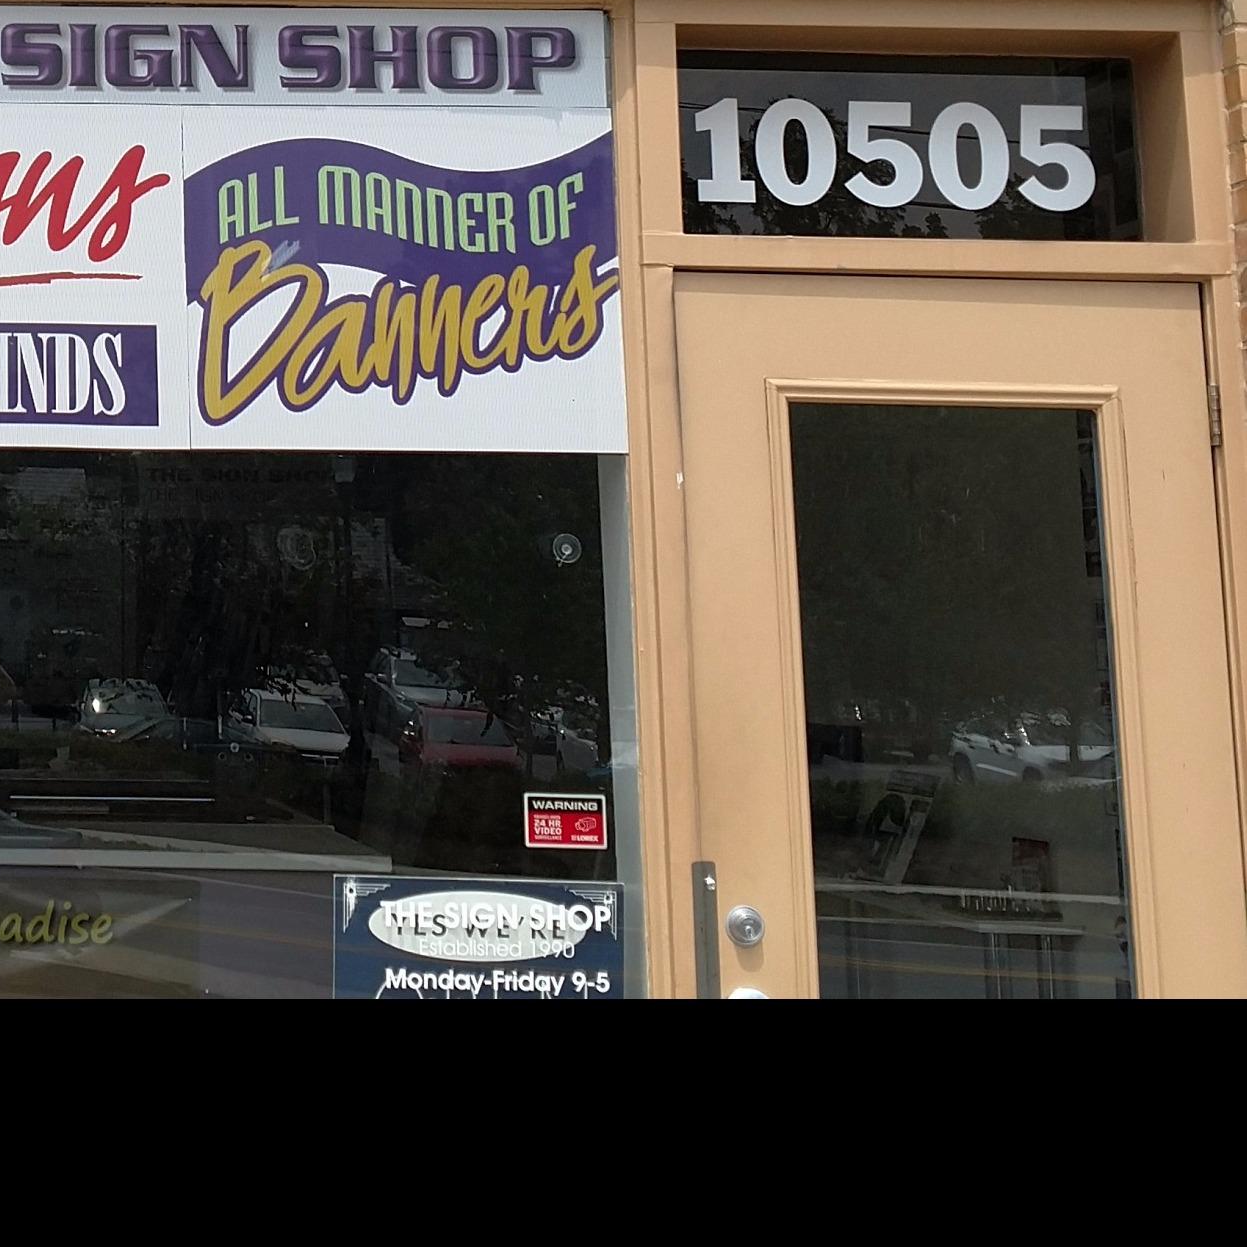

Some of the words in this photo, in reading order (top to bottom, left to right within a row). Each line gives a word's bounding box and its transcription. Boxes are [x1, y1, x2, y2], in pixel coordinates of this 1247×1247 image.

[0, 23, 252, 91] SIGN
[277, 24, 578, 92] SHOP
[693, 96, 1098, 213] 10505
[218, 165, 300, 245] ALL
[316, 164, 516, 255] MANNER
[528, 172, 584, 247] OF
[198, 239, 620, 422] Banners
[532, 800, 598, 811] WARNING
[534, 827, 562, 835] VIDEO
[380, 900, 433, 929] THE
[444, 901, 521, 930] SIGN
[529, 904, 612, 932] SHOP
[418, 939, 522, 960] Established
[530, 940, 576, 960] 1990
[384, 968, 566, 995] Monday-Friday
[571, 972, 612, 994] 9-5
